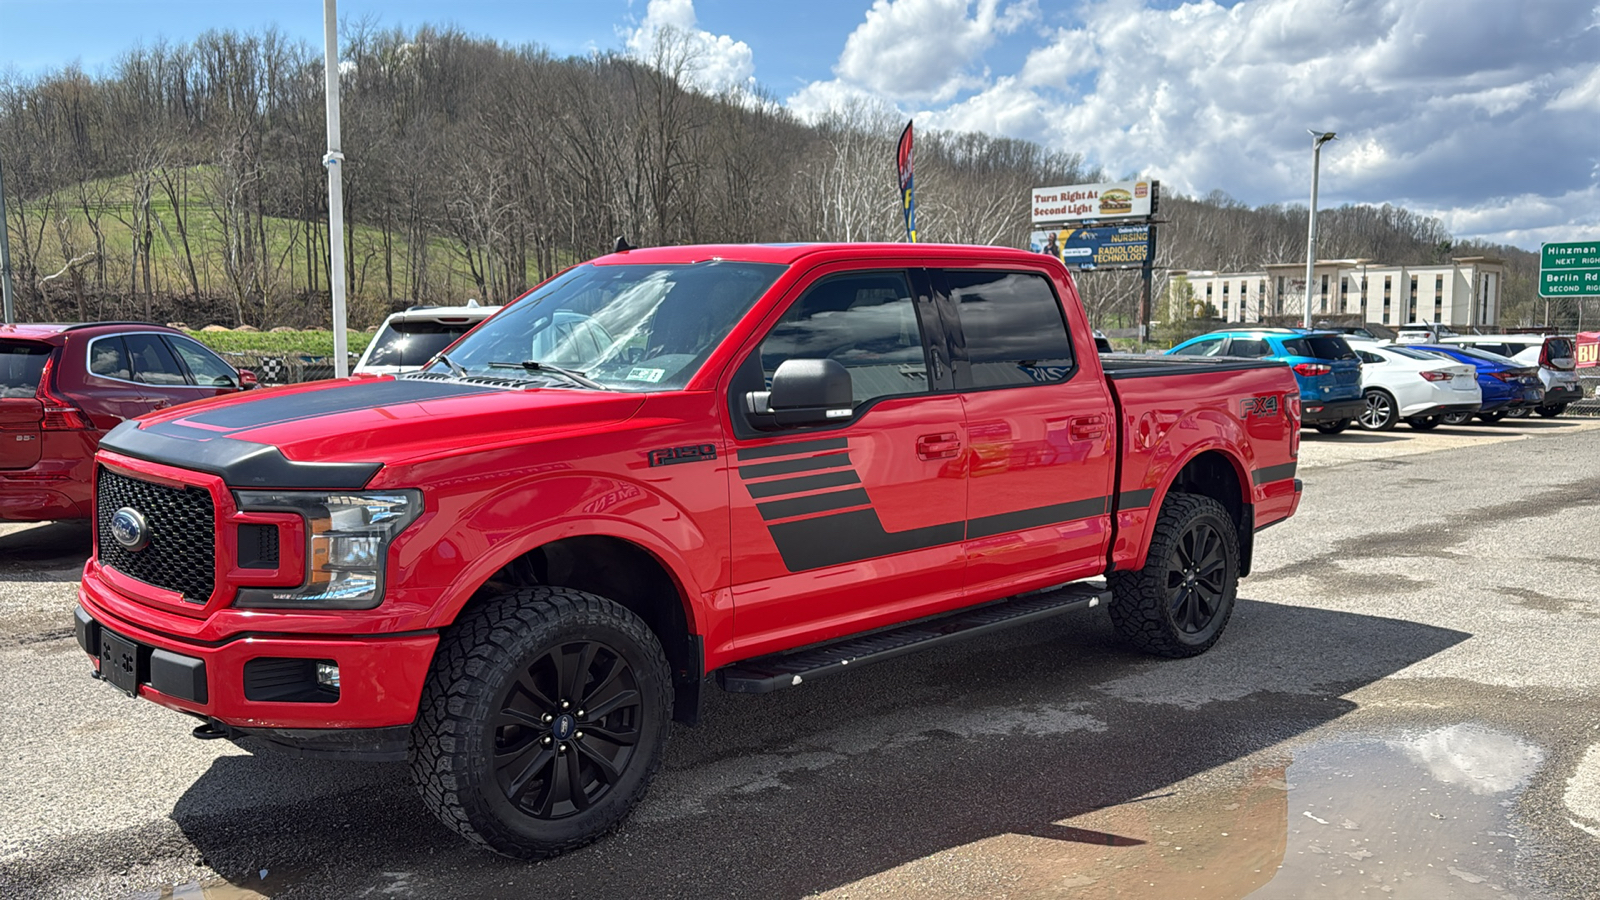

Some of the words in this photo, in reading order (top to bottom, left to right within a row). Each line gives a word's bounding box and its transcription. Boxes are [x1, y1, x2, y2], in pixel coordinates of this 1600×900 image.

[1034, 194, 1058, 204] Turn
[1060, 191, 1086, 203] Right
[1087, 190, 1099, 200] At
[1034, 205, 1067, 216] Second
[1068, 204, 1093, 216] Light
[1111, 233, 1148, 242] NURSING
[1098, 244, 1148, 255] RADIOLOGIC
[1547, 246, 1597, 256] Hinzman
[1093, 253, 1148, 263] TECHNOLOGY
[1555, 257, 1576, 266] NEXT
[1546, 273, 1579, 283] Berlin
[1584, 272, 1598, 282] Rd
[1548, 284, 1580, 293] SECOND
[1240, 396, 1278, 419] FX4
